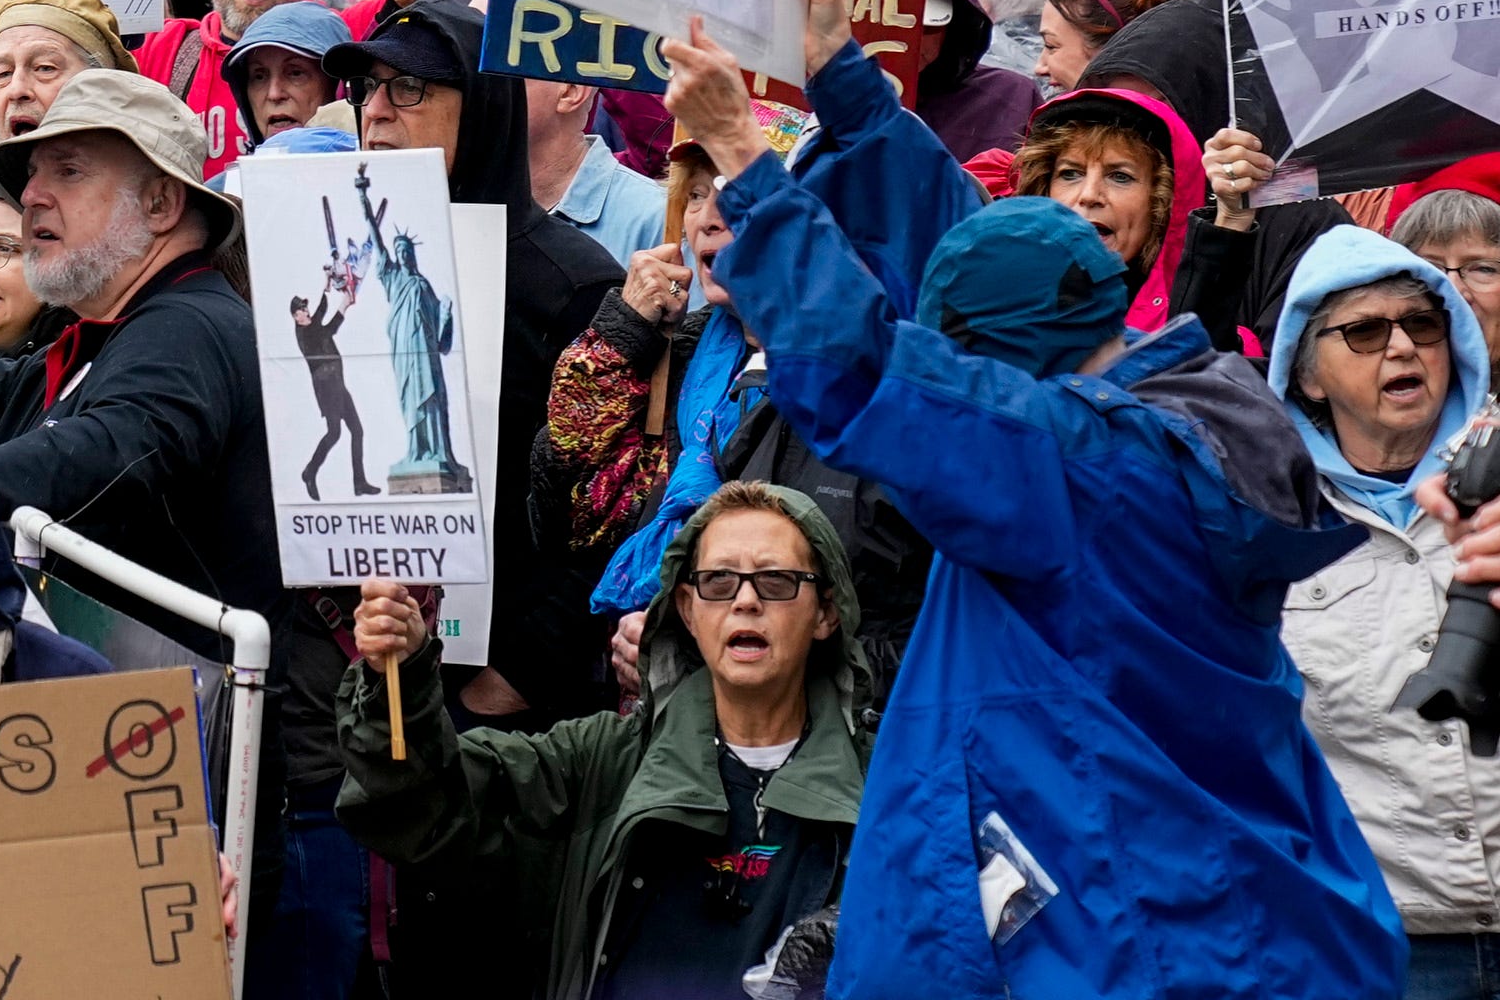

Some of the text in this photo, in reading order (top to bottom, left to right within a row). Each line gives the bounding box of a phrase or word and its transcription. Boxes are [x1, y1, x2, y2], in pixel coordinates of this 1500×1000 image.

[1338, 6, 1426, 34] HANDS
[814, 485, 853, 498] patagonia
[291, 513, 476, 536] STOP THE WAR ON
[327, 546, 449, 578] LIBERTY
